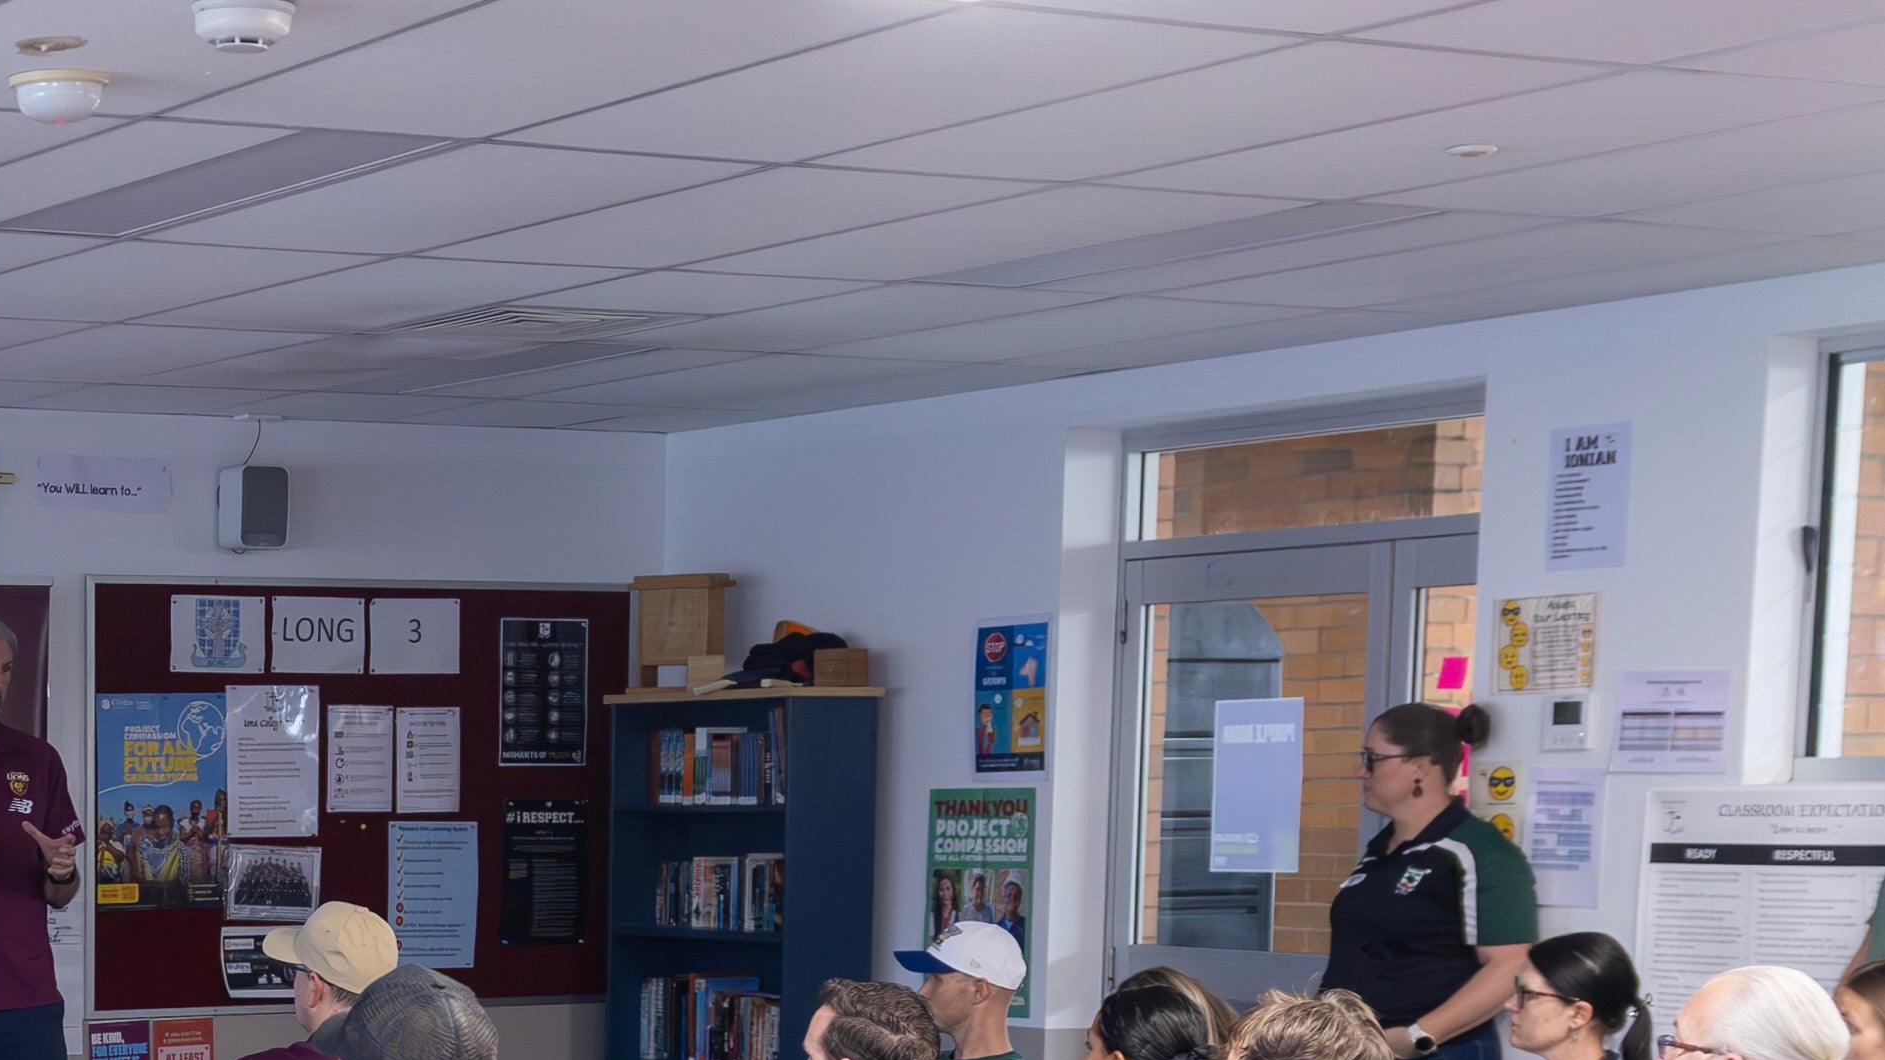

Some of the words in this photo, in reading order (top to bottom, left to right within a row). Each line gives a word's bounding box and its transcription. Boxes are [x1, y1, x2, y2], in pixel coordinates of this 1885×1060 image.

[1575, 435, 1599, 452] AM
[65, 483, 89, 495] WILL
[90, 483, 118, 496] learn
[283, 617, 354, 643] LONG
[408, 618, 422, 643] 3
[986, 642, 1006, 654] STOP
[124, 740, 159, 756] FOR
[162, 740, 197, 755] ALL
[124, 756, 197, 773] FUTURE
[6, 773, 30, 782] LIONS
[1718, 804, 1796, 817] CLASSROOM
[936, 818, 1011, 837] PROJECT
[934, 838, 1028, 854] COMPASSION
[1685, 848, 1717, 860] READY
[1772, 849, 1836, 862] RESPECTFUL
